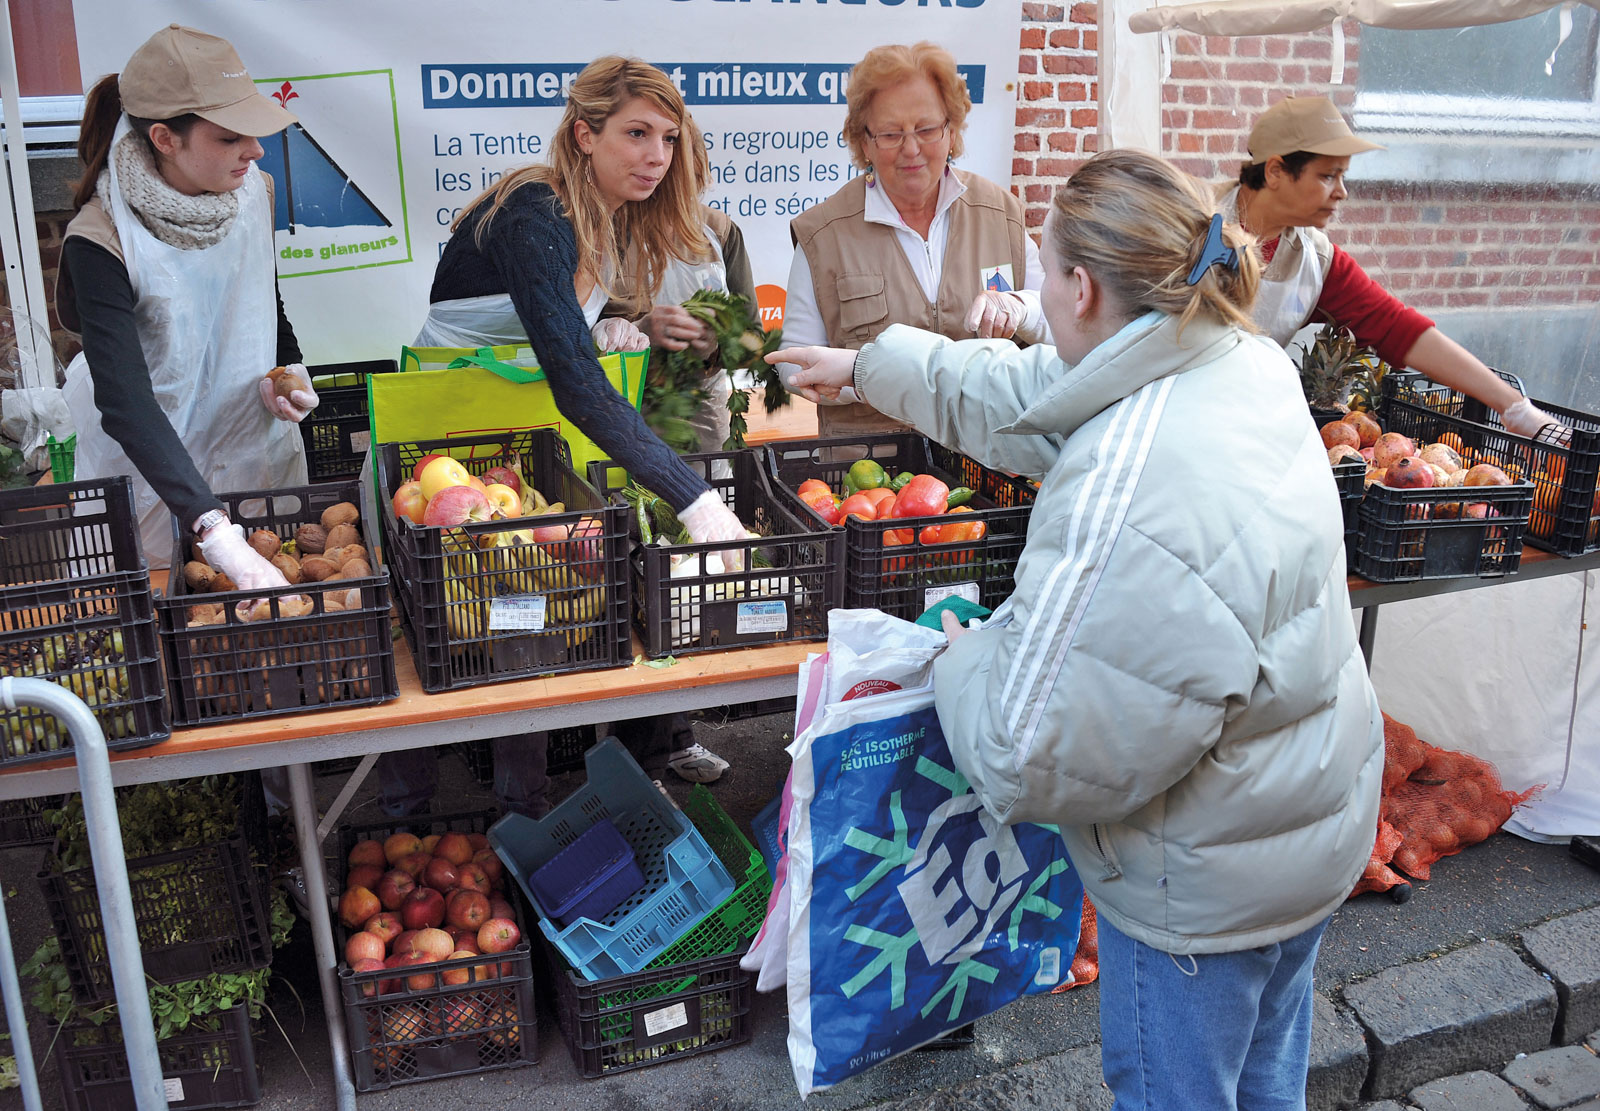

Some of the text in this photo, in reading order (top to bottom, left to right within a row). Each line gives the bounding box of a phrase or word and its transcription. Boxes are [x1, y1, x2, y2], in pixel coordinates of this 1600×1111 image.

[697, 65, 808, 97] mieux
[434, 132, 542, 156] La Tente
[723, 130, 829, 155] regroupe
[435, 168, 472, 192] les
[744, 160, 800, 184] dans
[808, 159, 839, 182] les
[707, 196, 731, 216] et
[738, 194, 767, 217] de
[280, 235, 399, 260] des glaneurs
[854, 680, 889, 693] NOUVEAU
[841, 727, 926, 762] SAC ISOTHERME
[896, 807, 1030, 967] Ed
